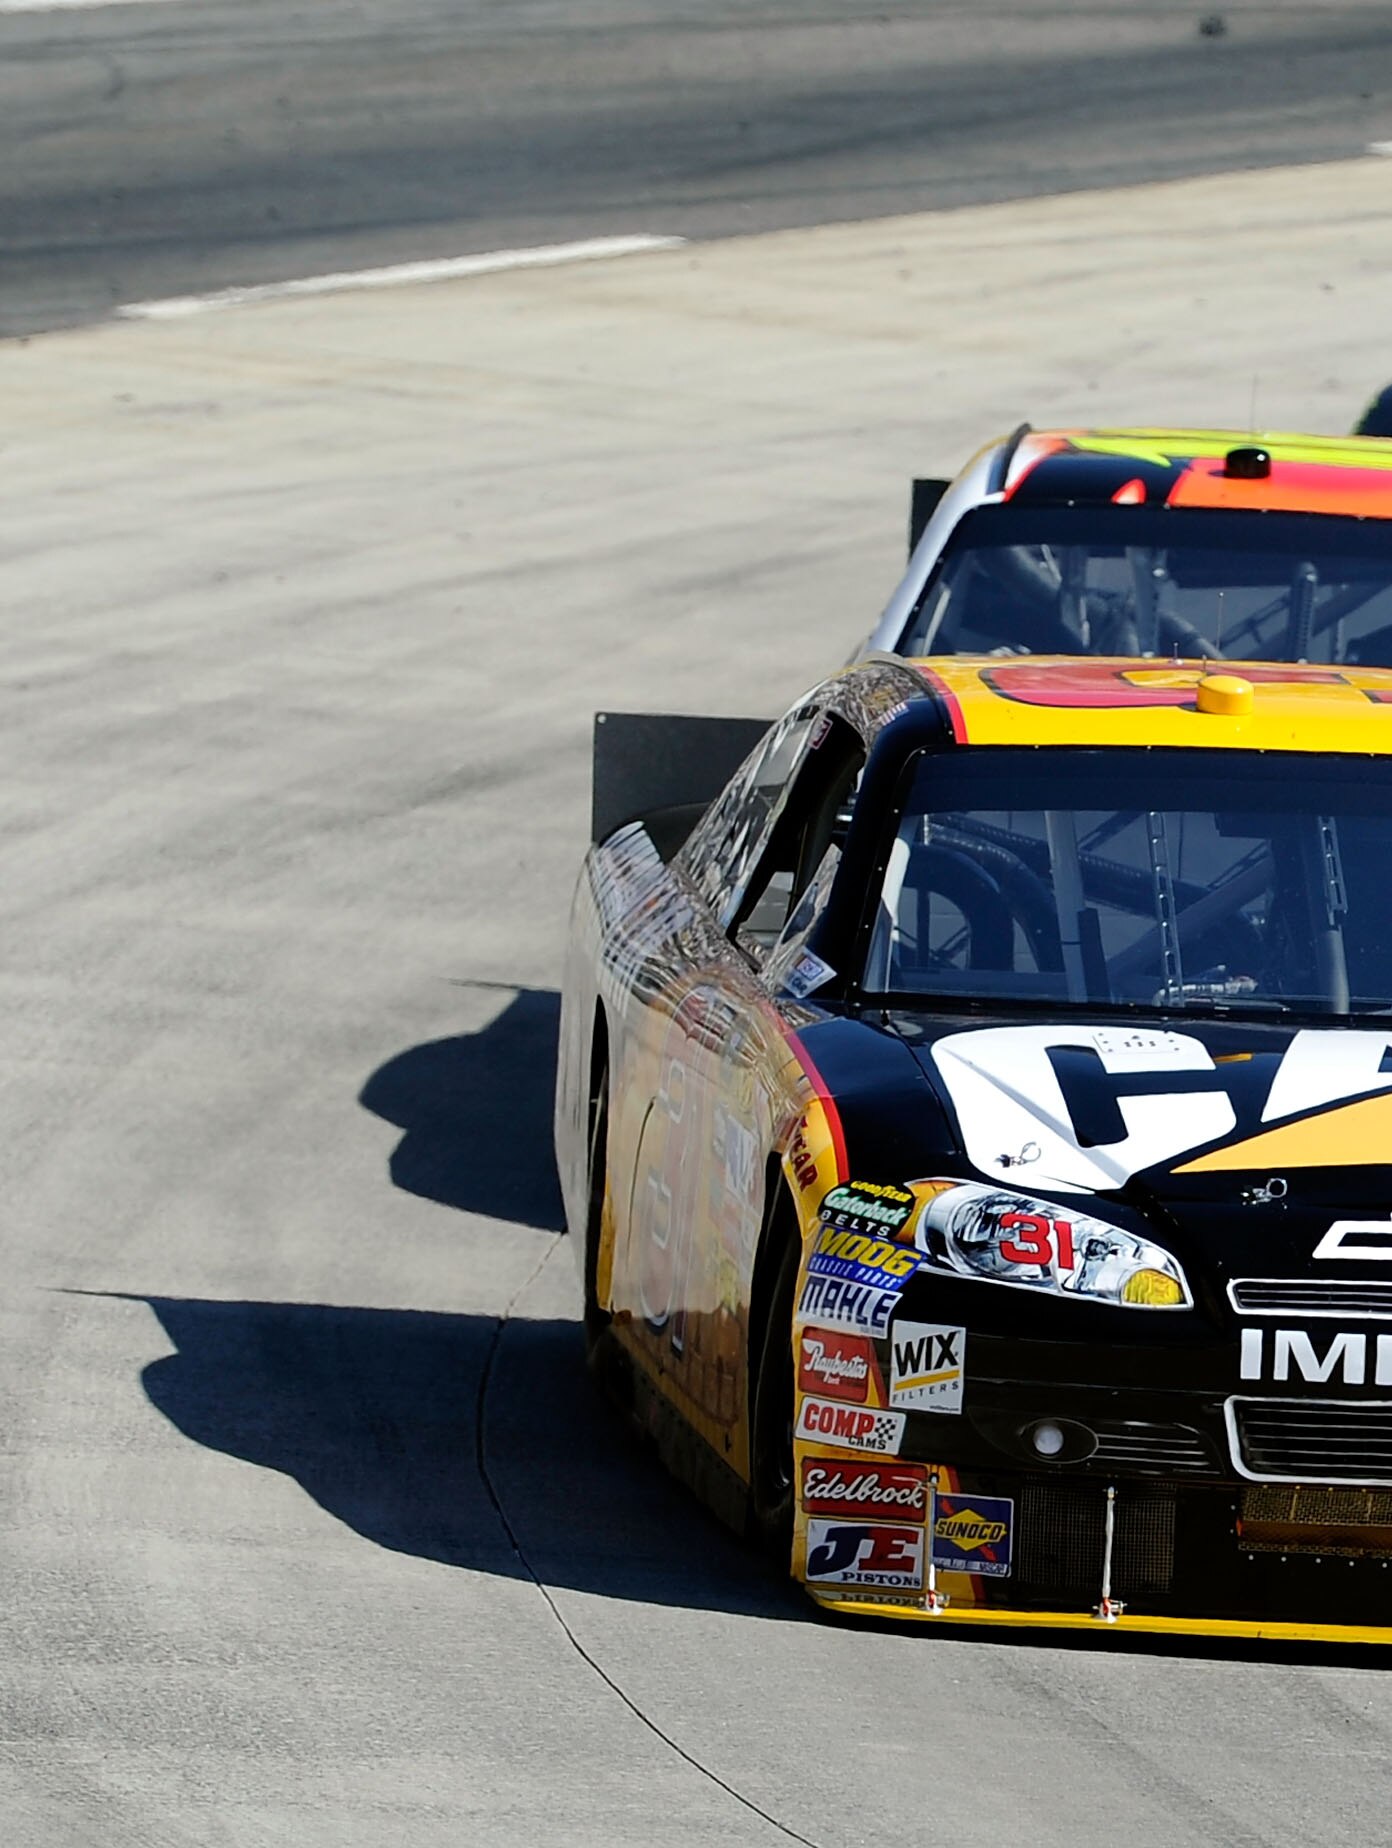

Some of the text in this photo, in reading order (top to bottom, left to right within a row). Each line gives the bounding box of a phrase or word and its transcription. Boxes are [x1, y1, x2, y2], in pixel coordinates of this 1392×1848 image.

[820, 1210, 890, 1236] BELTS
[815, 1227, 922, 1276] MOOG
[1000, 1213, 1074, 1271] 31
[799, 1276, 897, 1329] MAHLE
[895, 1331, 960, 1377] WIX
[892, 1381, 959, 1403] FILTERS
[804, 1403, 875, 1438] COMP
[848, 1435, 887, 1450] CAMS
[803, 1468, 924, 1508] Edelbrock
[936, 1521, 1002, 1540] SUNOCO
[807, 1526, 919, 1576] JE
[841, 1571, 921, 1588] PISTONS
